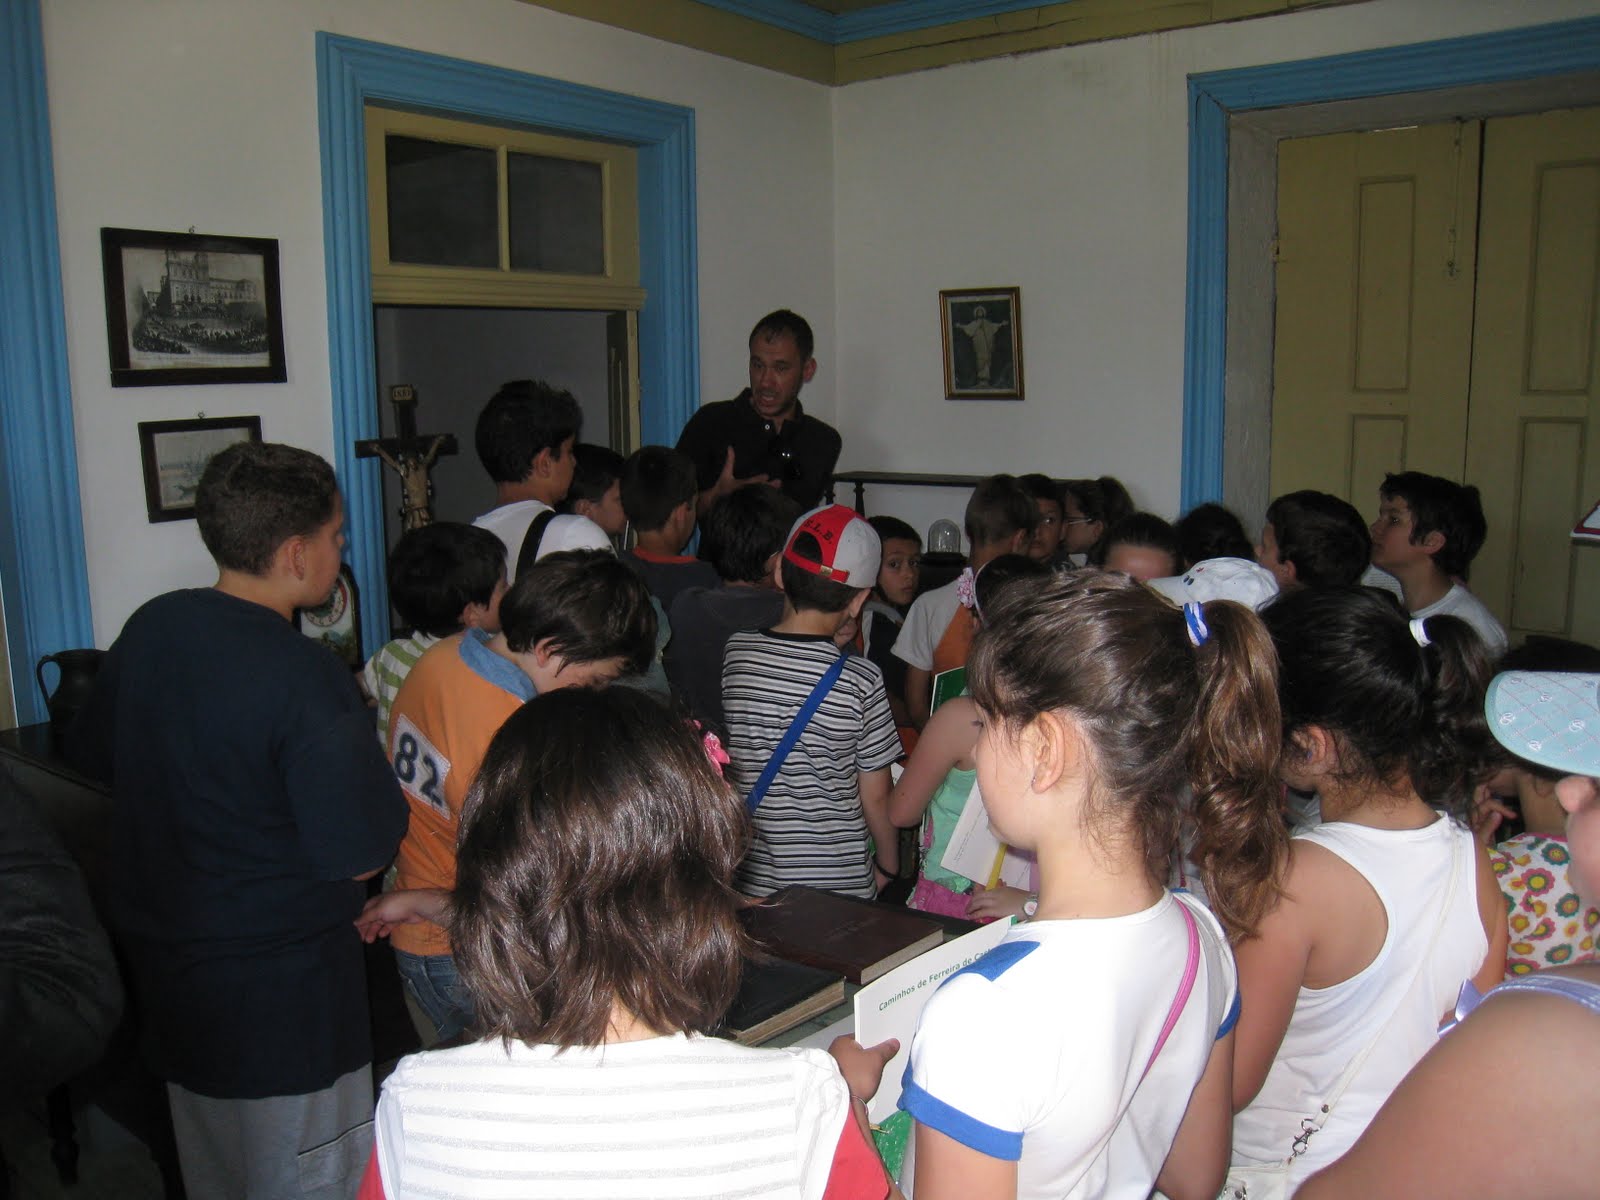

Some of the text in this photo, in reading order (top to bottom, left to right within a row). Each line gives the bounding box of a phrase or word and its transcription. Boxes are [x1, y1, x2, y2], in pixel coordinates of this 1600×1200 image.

[395, 732, 443, 808] 82
[878, 985, 916, 1011] Caminhos
[917, 980, 927, 988] de
[929, 962, 961, 983] Ferreira
[962, 957, 972, 966] de
